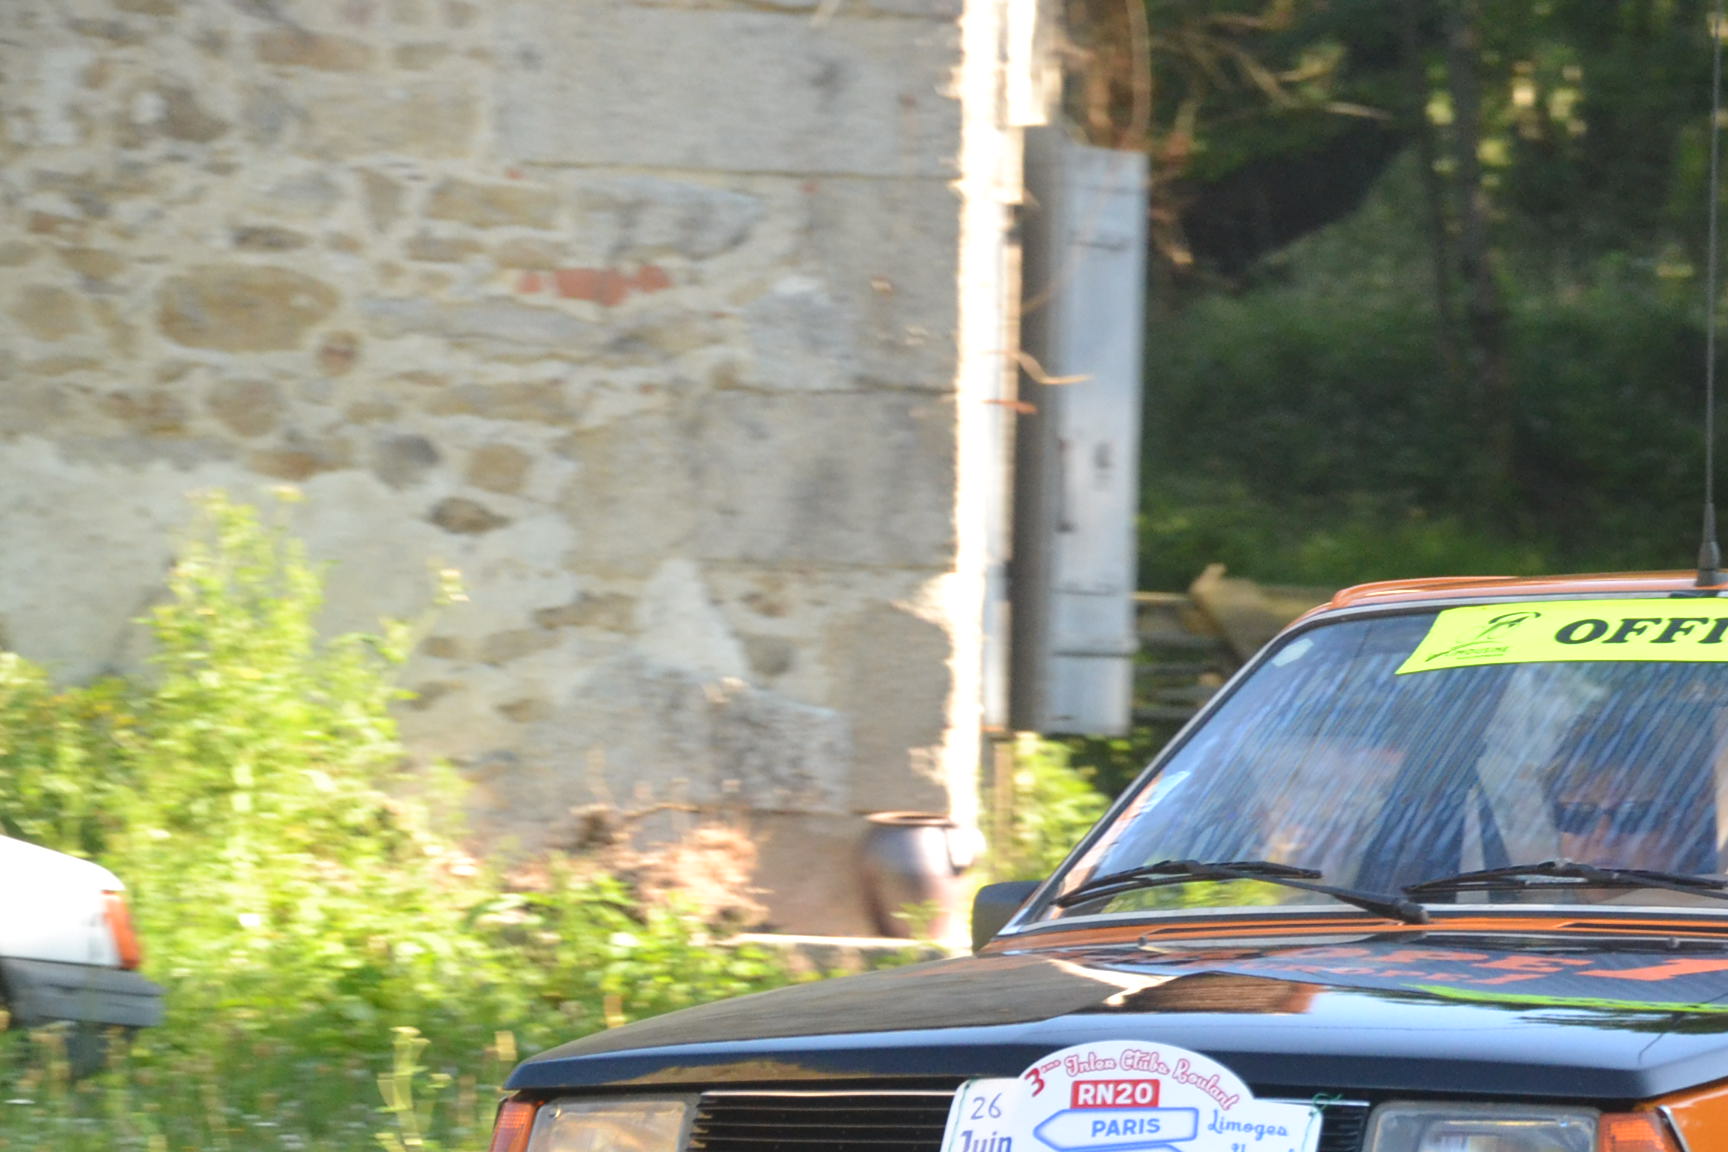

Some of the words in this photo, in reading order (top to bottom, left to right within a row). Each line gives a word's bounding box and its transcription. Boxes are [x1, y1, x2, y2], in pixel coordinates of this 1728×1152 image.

[1077, 1083, 1154, 1105] RN20
[970, 1093, 1003, 1121] 26
[1091, 1118, 1161, 1138] PARIS
[1208, 1109, 1288, 1141] Limoges
